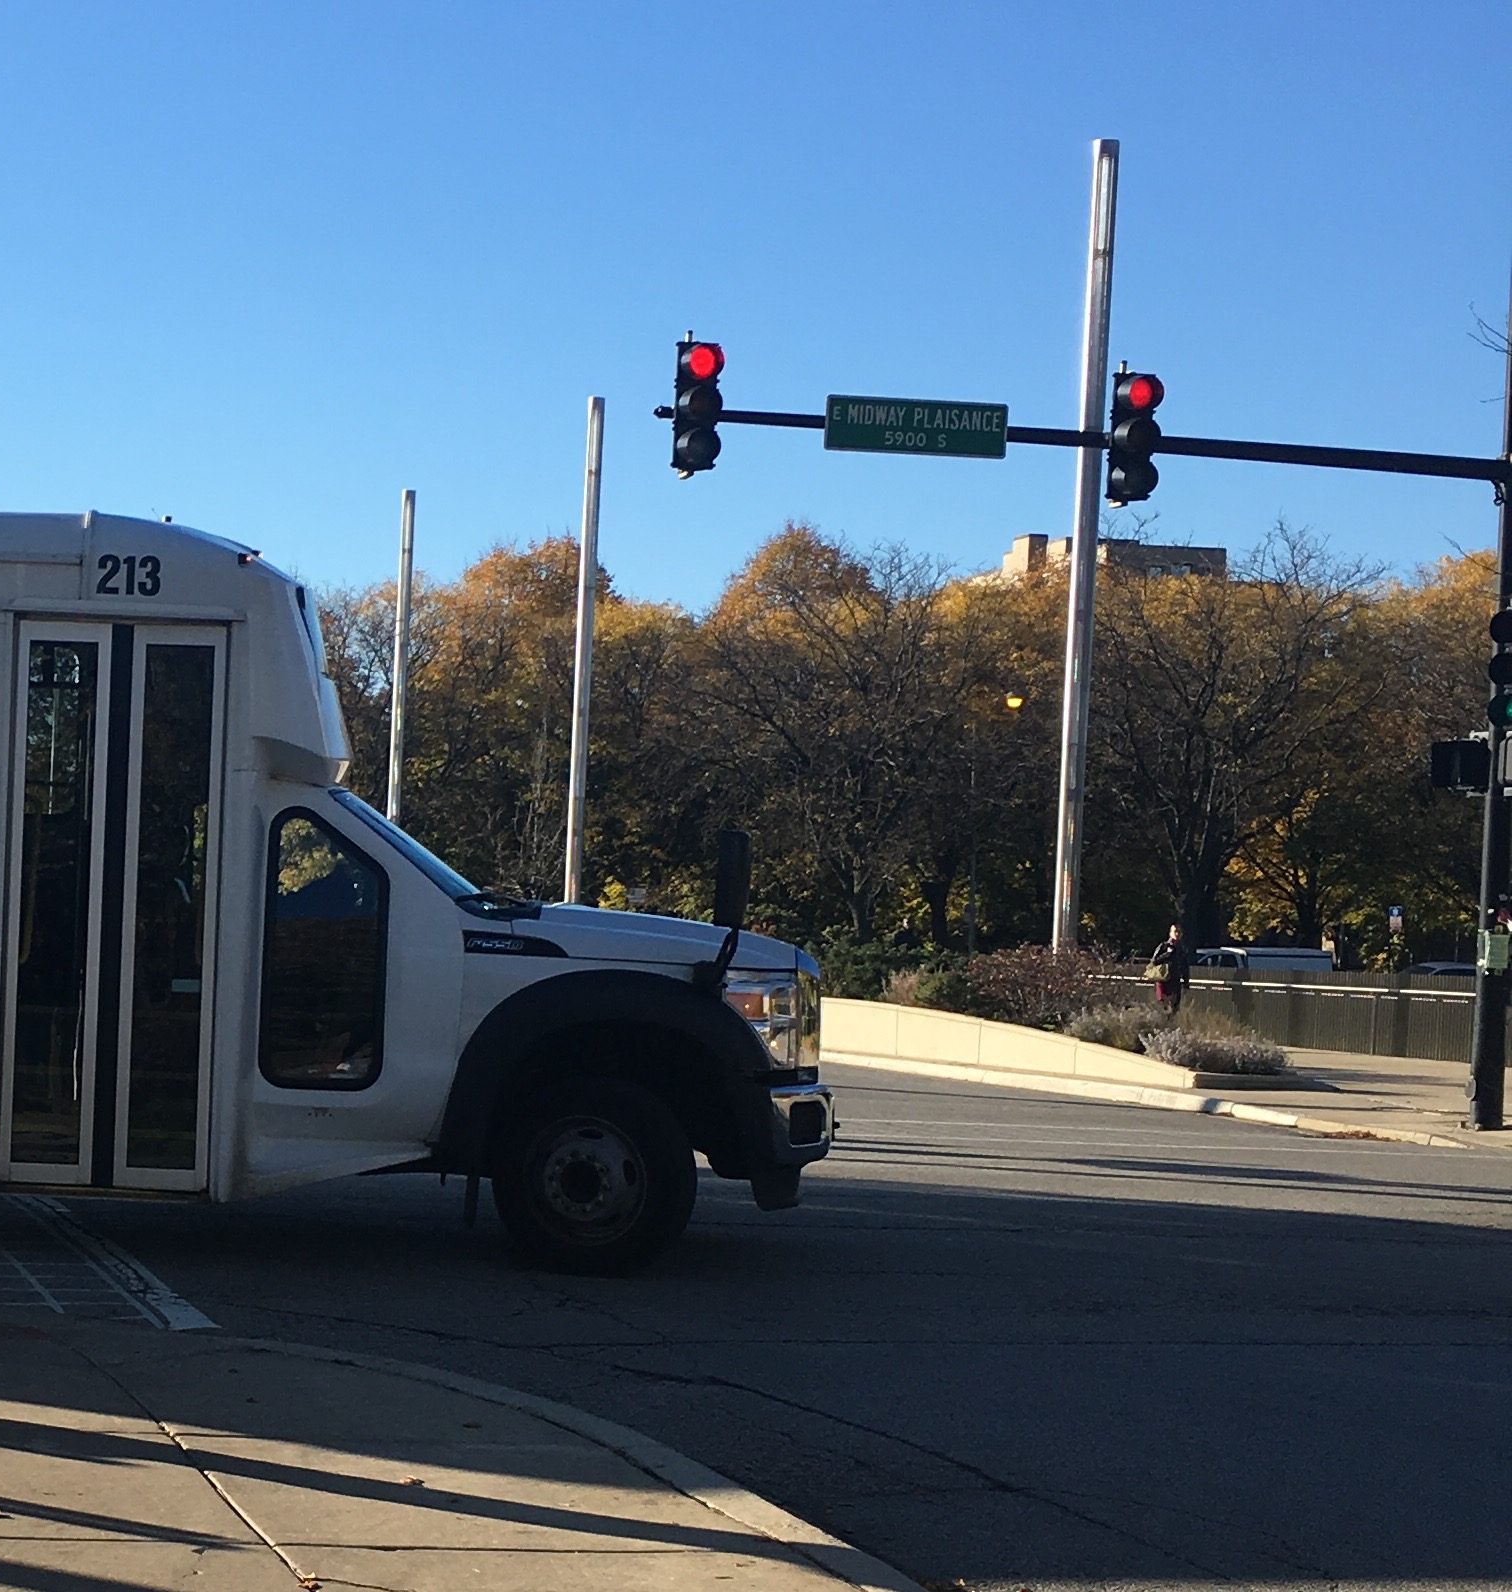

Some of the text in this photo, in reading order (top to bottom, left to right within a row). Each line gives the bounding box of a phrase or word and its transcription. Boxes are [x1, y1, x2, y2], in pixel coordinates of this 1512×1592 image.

[833, 404, 1001, 432] E MIDWAY PLAISANCE
[885, 431, 947, 448] 5900 S
[96, 554, 162, 597] 213
